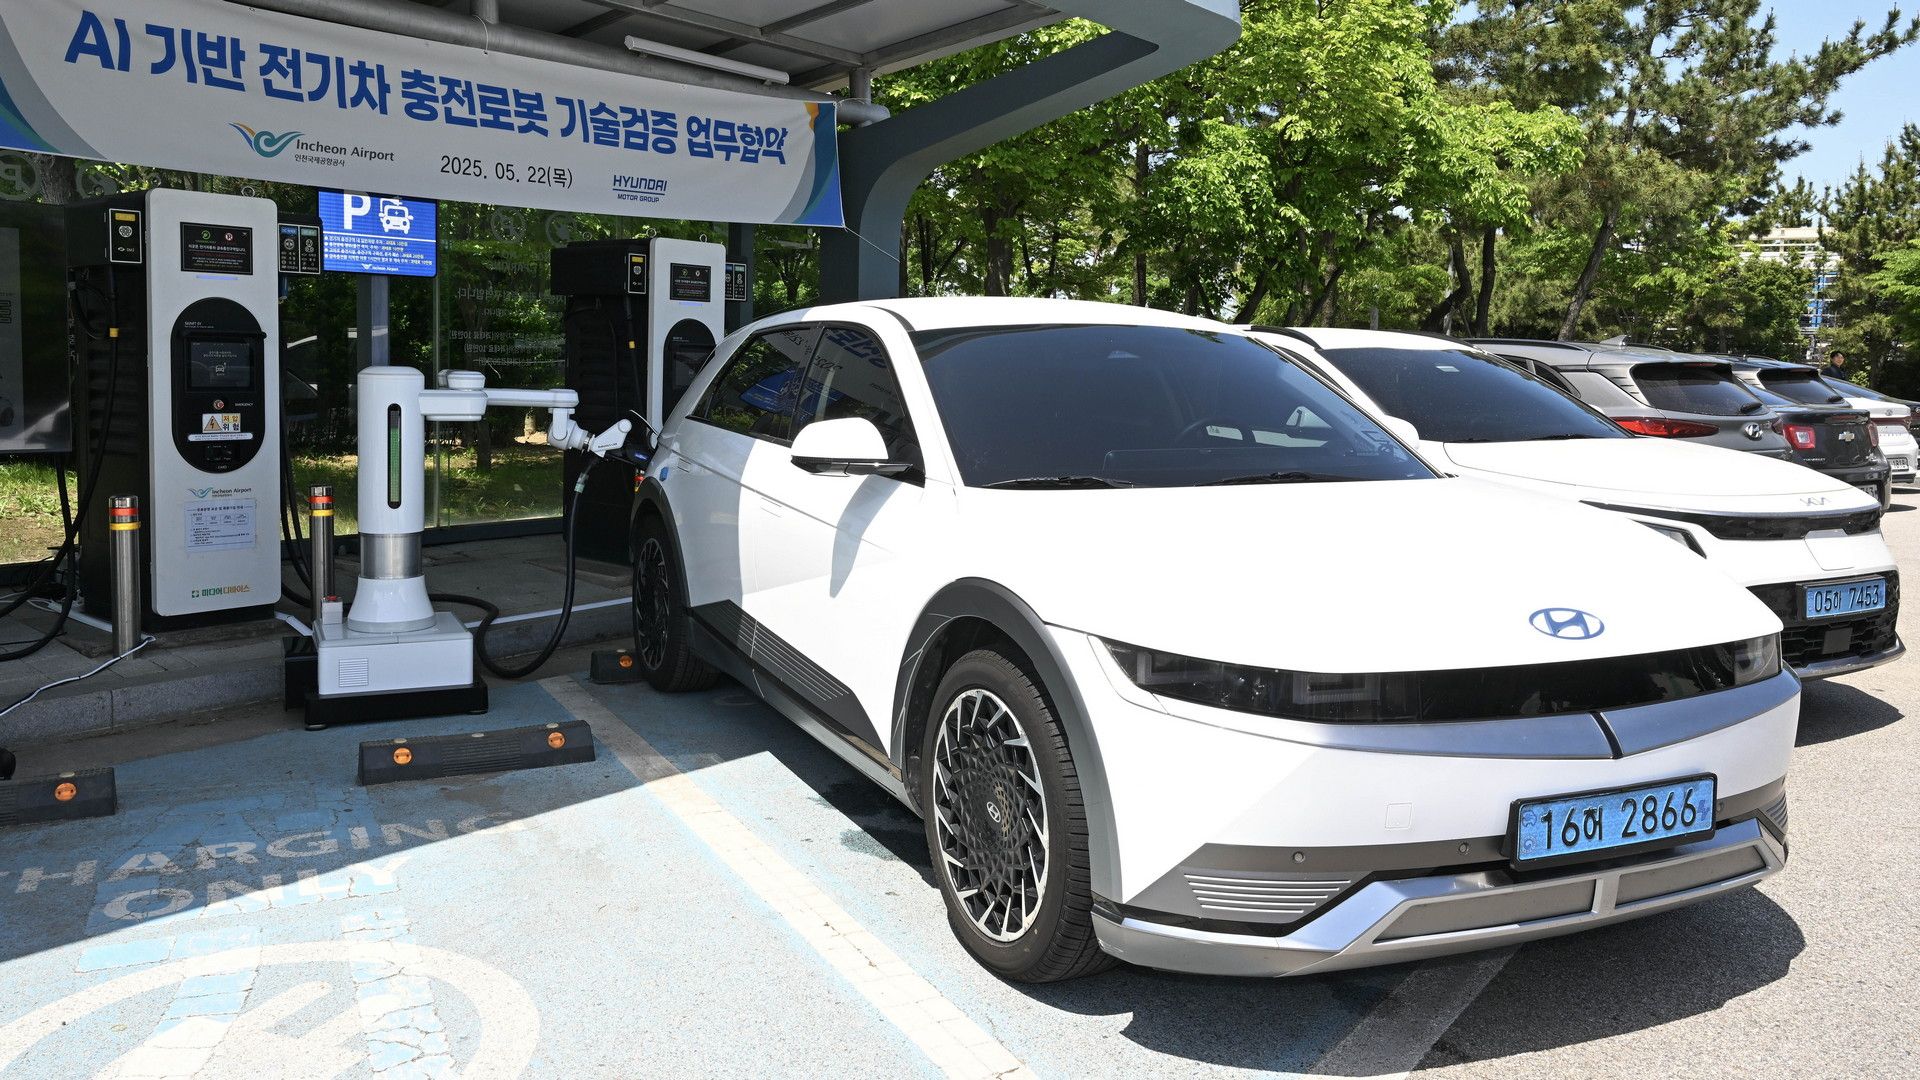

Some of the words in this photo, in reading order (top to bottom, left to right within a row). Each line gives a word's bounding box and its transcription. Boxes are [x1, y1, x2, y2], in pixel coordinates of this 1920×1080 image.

[64, 10, 131, 72] AI
[145, 23, 246, 92] 기반
[259, 42, 391, 116] 전기차
[401, 69, 548, 138] 충전로봇
[556, 96, 678, 155] 기술검증
[686, 115, 789, 166] 업무협약
[294, 154, 345, 167] 인천국제공항공사
[296, 139, 347, 155] Incheon
[351, 146, 395, 161] Airport
[440, 154, 488, 180] 2025.
[495, 161, 521, 184] 05.
[527, 164, 573, 189] 22(목)
[613, 175, 668, 192] HYUNDAI
[344, 192, 371, 230] P
[640, 195, 660, 203] GROUP
[1849, 584, 1879, 609] 7453
[1541, 806, 1604, 850] 16허
[1621, 788, 1697, 838] 2866
[0, 811, 527, 895] HARGING
[103, 856, 411, 921] ONLY
